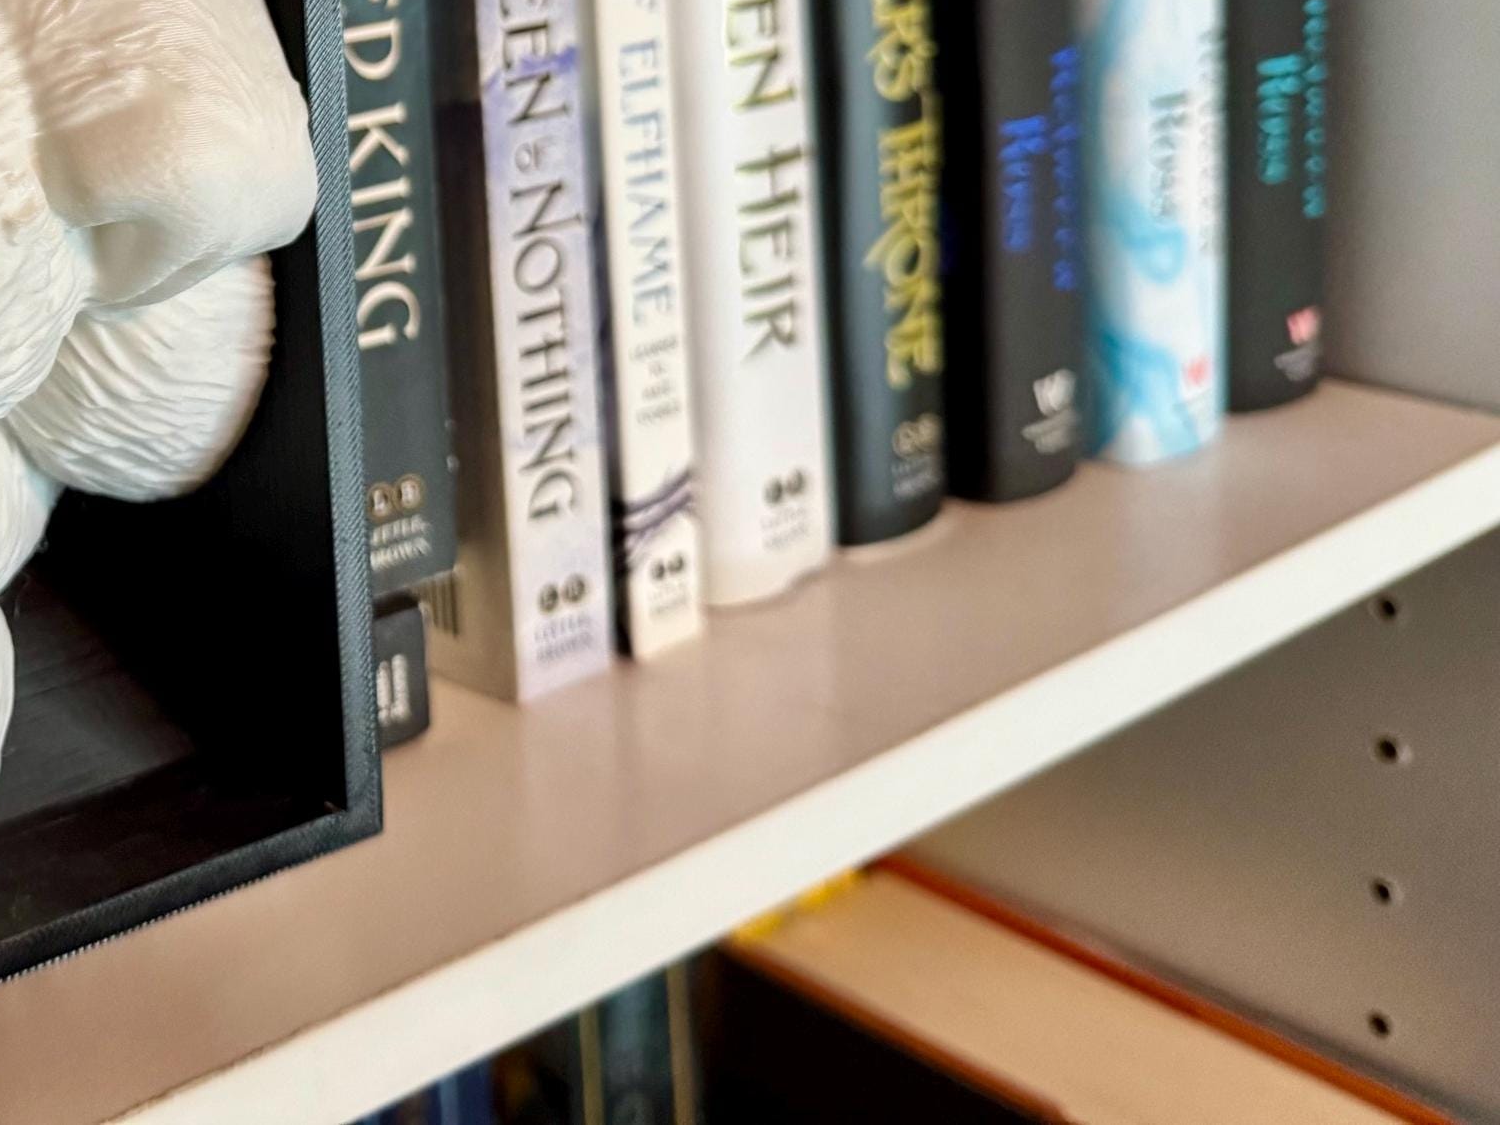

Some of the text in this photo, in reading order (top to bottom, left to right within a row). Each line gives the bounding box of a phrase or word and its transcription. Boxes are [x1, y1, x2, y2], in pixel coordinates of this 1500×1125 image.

[347, 101, 421, 350] KING
[618, 39, 677, 326] ELFHAME
[736, 145, 813, 362] HEIR
[508, 179, 583, 524] NOTHING
